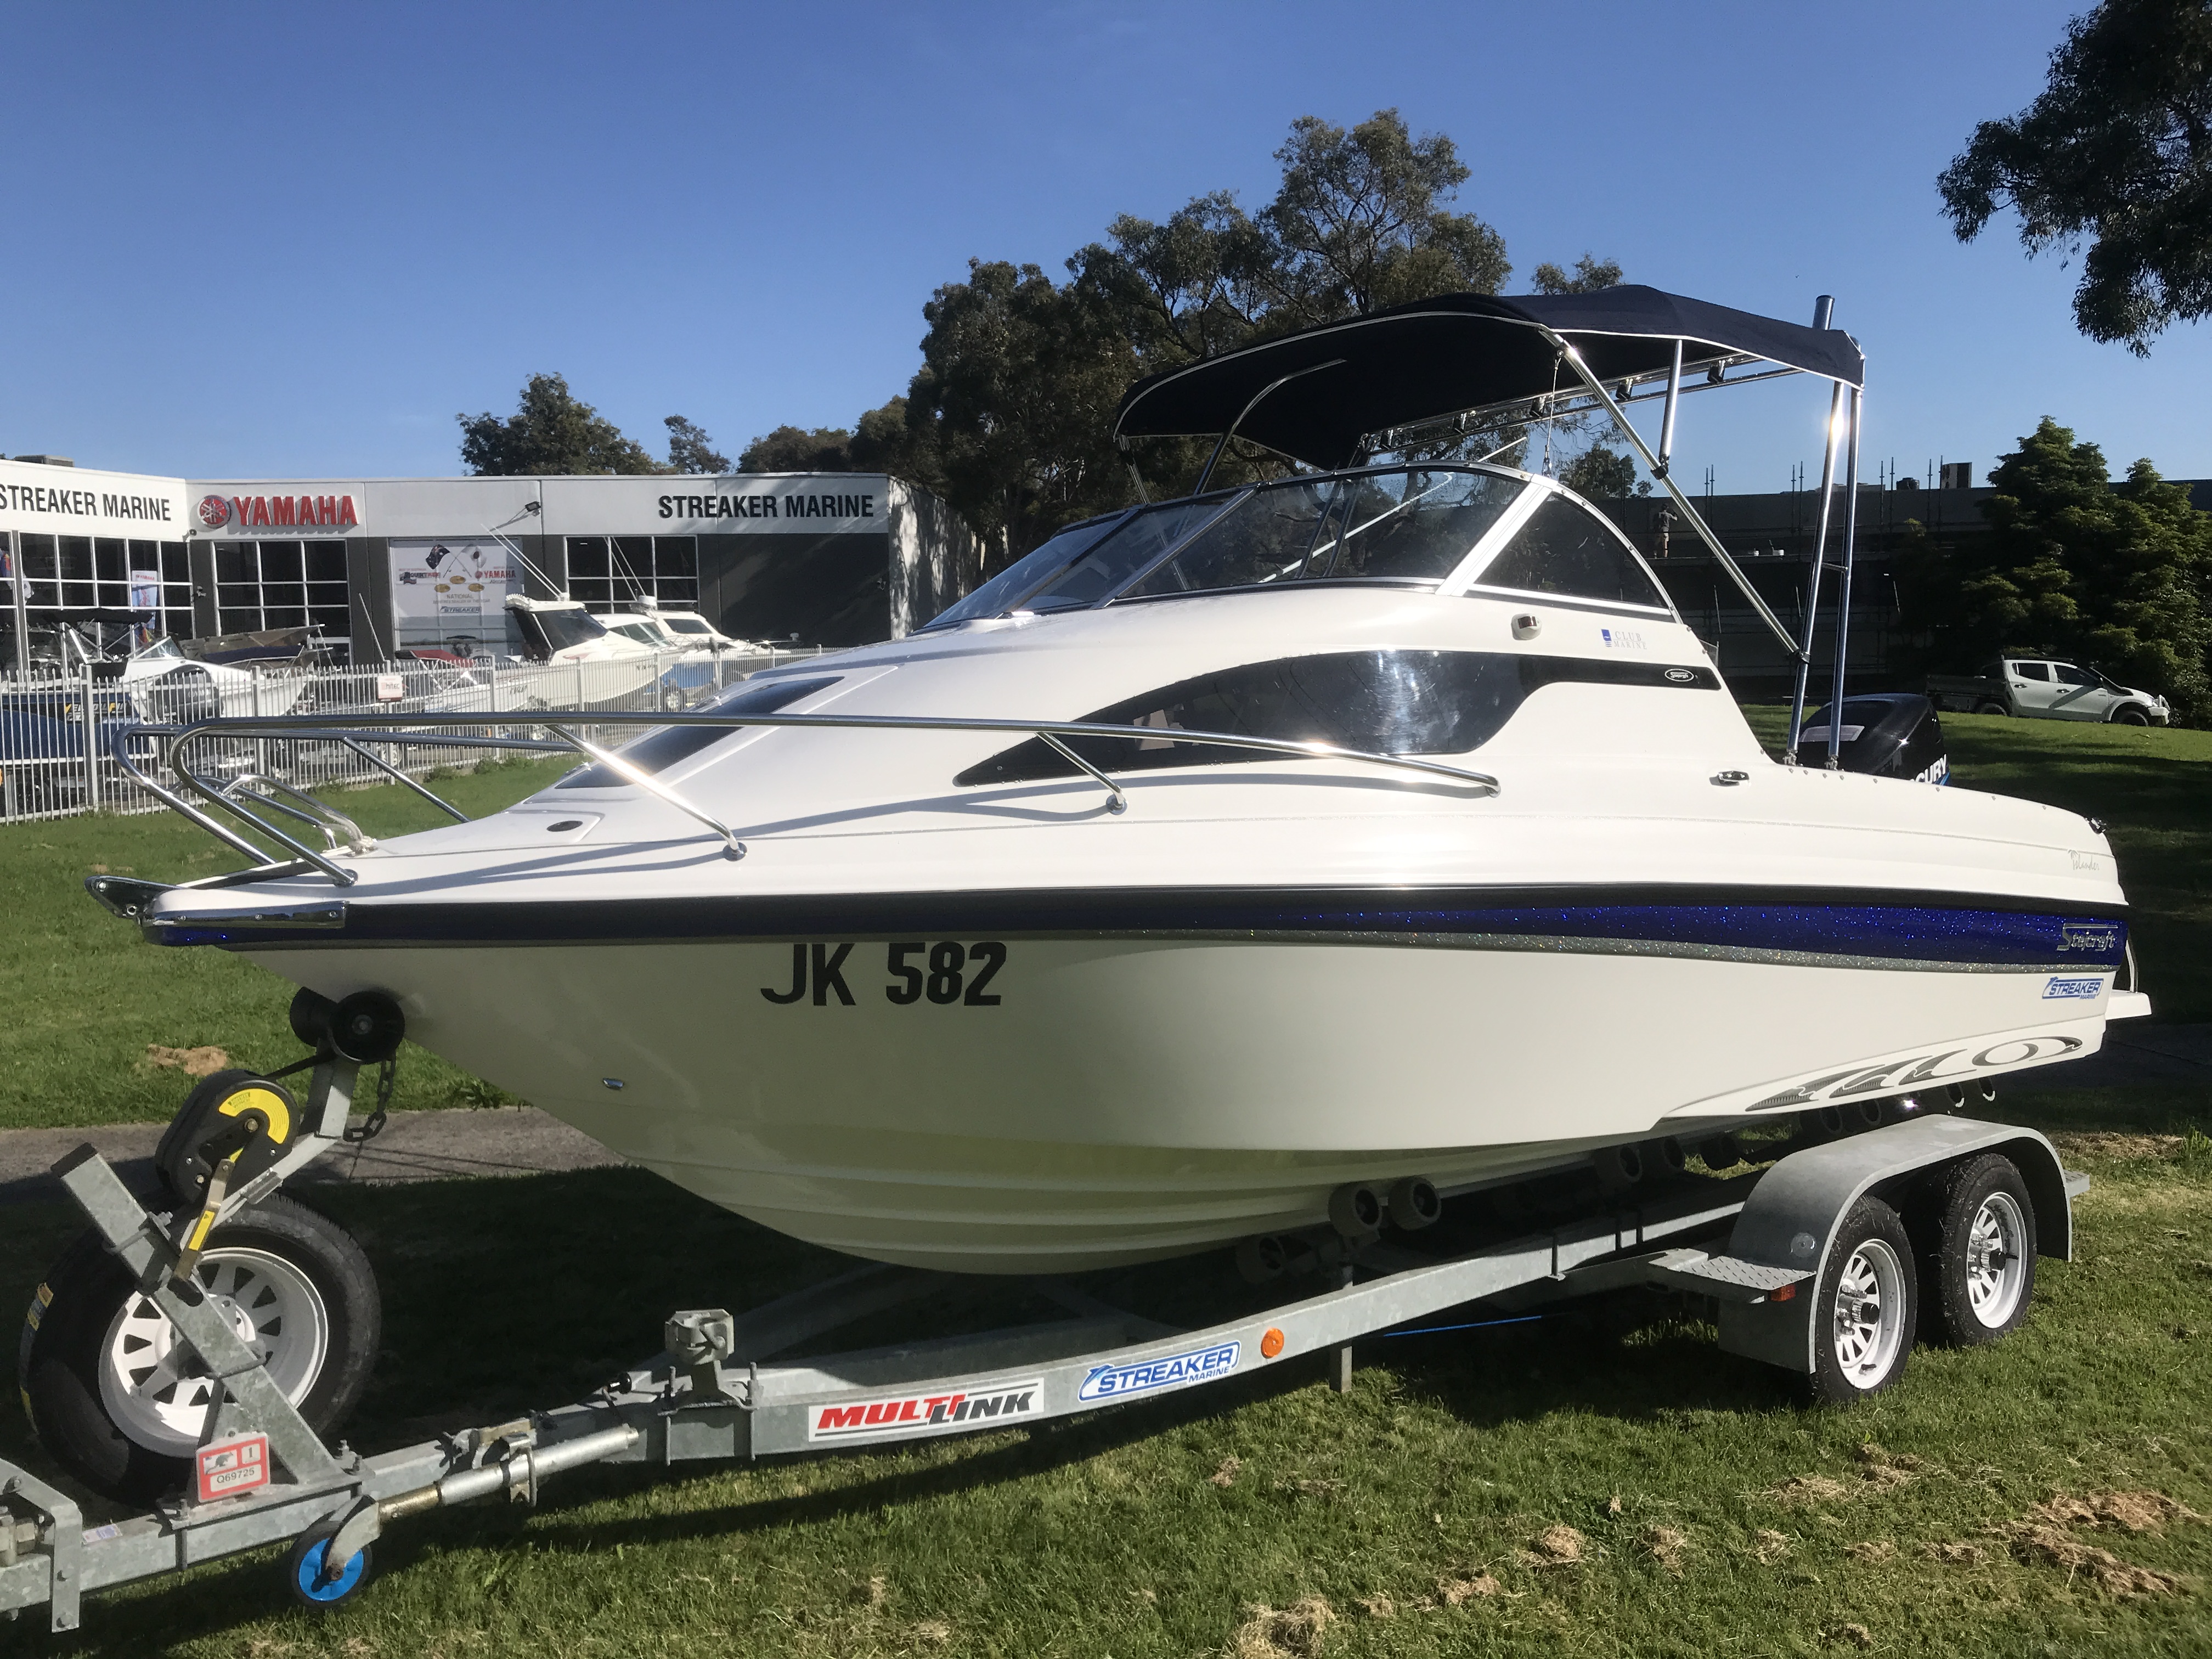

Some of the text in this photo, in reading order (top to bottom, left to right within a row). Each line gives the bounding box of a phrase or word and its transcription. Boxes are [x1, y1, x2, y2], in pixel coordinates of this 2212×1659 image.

[102, 493, 171, 521] MARINE
[233, 495, 359, 526] YAMAHA
[658, 495, 874, 518] STREAKER MARINE
[483, 570, 516, 579] YAMAHA
[1613, 640, 1647, 650] MARINE
[1615, 631, 1641, 641] CLUB
[1909, 754, 1946, 784] CURY
[760, 941, 1007, 1006] JK 582
[2049, 981, 2101, 995] STREAKER
[1098, 1347, 1234, 1393] STREAKER
[1188, 1367, 1230, 1383] MARINE
[216, 1467, 255, 1483] Q69725
